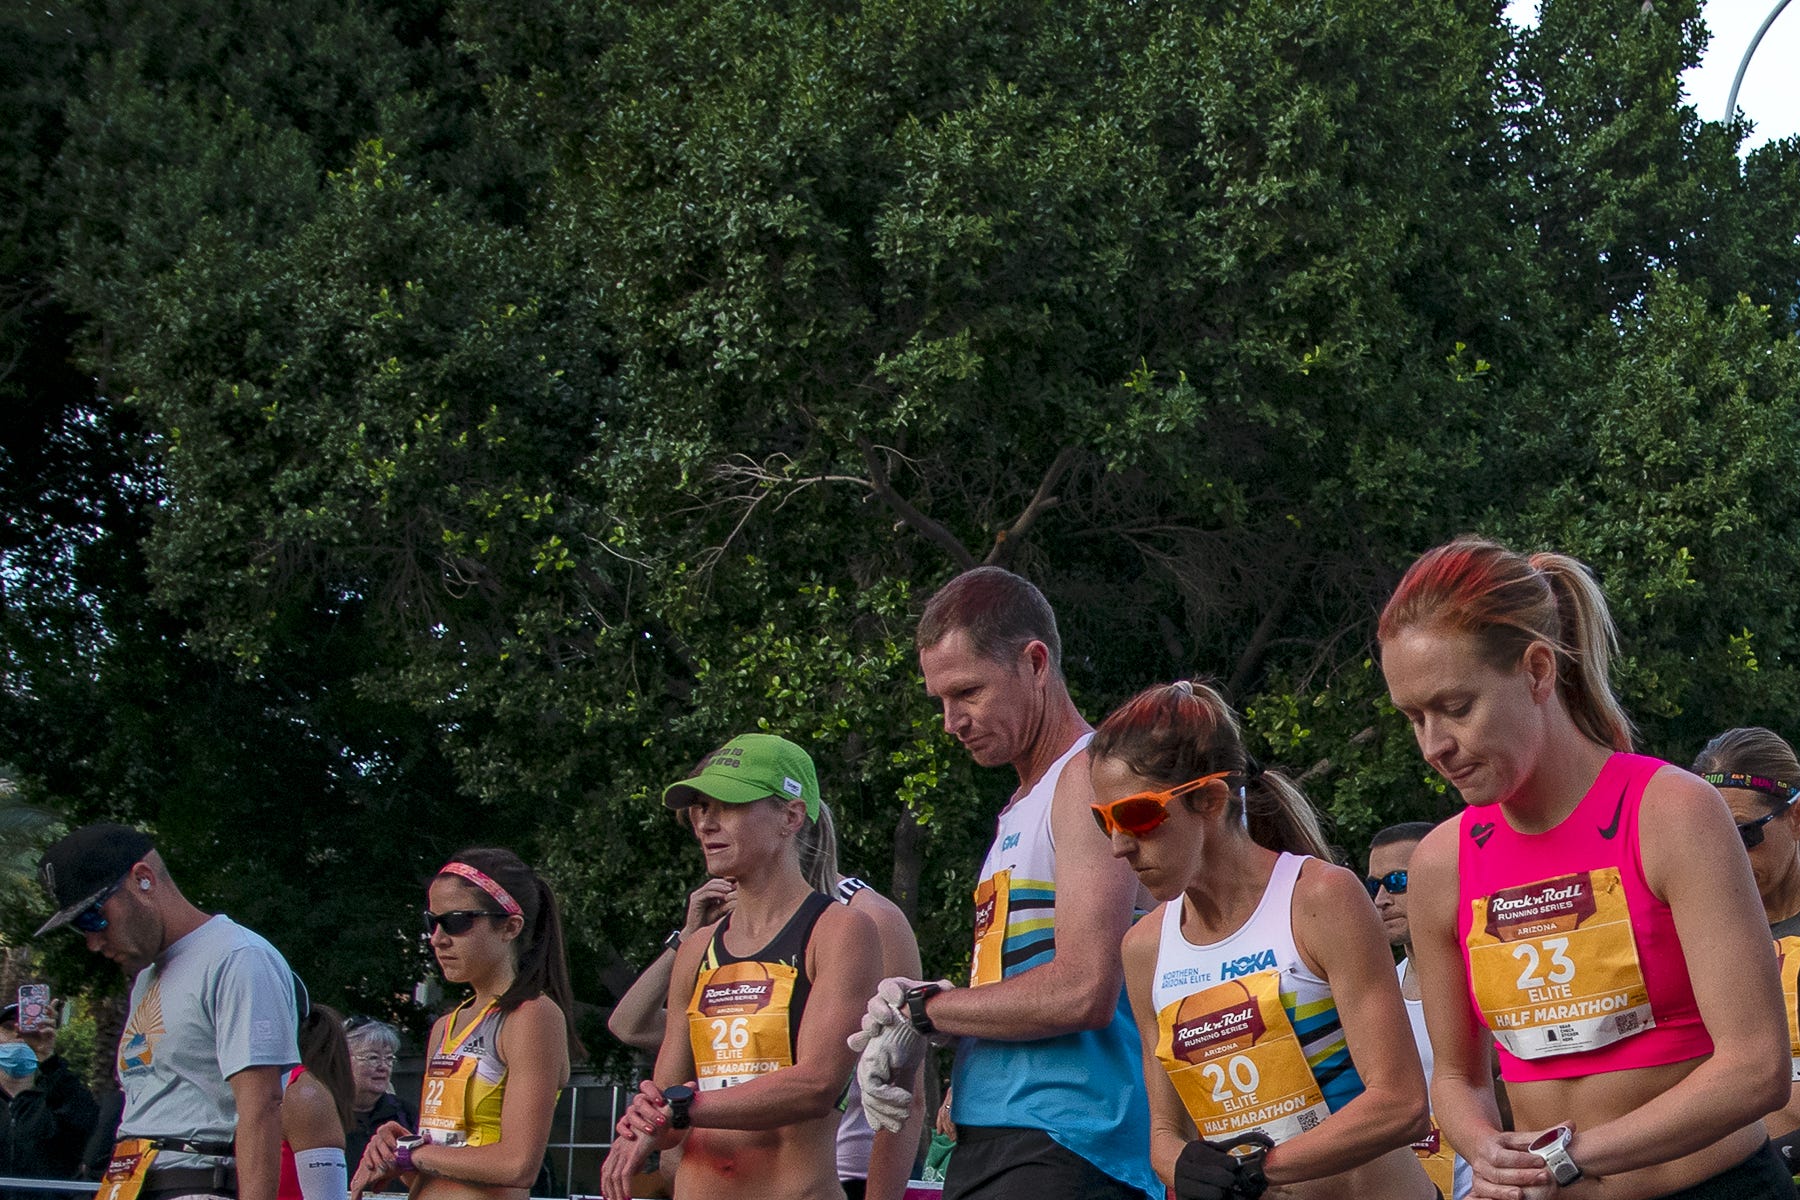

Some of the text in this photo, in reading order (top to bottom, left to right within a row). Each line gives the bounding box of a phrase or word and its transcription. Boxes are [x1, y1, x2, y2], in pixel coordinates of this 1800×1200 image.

[1497, 900, 1573, 921] RUNNING SERIES
[1517, 922, 1557, 935] ARIZONA
[1162, 967, 1198, 979] NORTHERN
[1220, 948, 1278, 981] HOKA
[1512, 937, 1576, 990] 23
[1161, 972, 1211, 989] ARIZONA ELITE
[1527, 983, 1573, 1003] ELITE
[1495, 1011, 1530, 1027] HALF
[1534, 993, 1629, 1023] MARATHON
[711, 1017, 750, 1051] 26
[1184, 1022, 1249, 1047] RUNNING SERIES
[716, 1048, 742, 1059] ELITE
[1204, 1042, 1238, 1057] ARIZONA
[717, 1061, 778, 1073] MARATHON
[1202, 1054, 1260, 1102] 20
[425, 1079, 445, 1106] 22
[1222, 1092, 1260, 1113] ELITE
[1203, 1118, 1229, 1132] HALF
[1231, 1094, 1307, 1129] MARATHON
